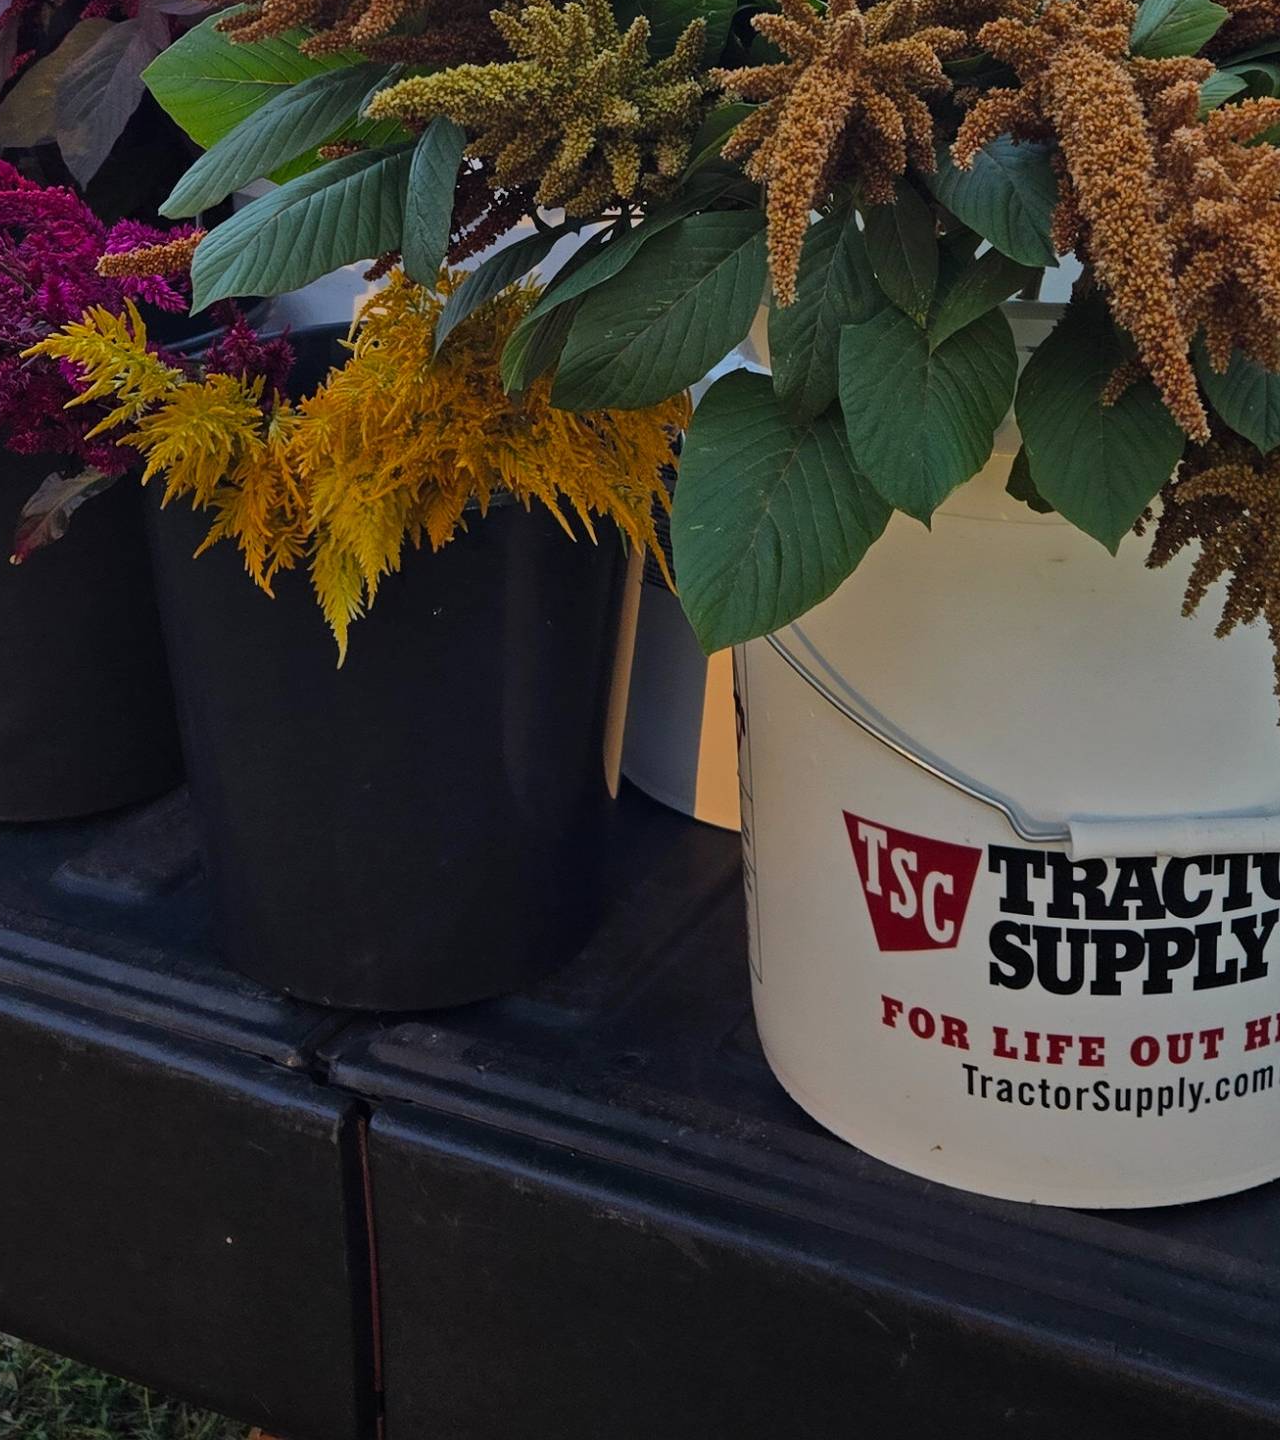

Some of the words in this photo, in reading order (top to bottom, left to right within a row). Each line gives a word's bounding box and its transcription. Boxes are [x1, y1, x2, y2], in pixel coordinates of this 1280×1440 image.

[857, 821, 956, 944] TSC
[988, 908, 1280, 996] SUPPLY
[880, 993, 971, 1051] FOR
[992, 1025, 1106, 1068] LIFE
[1129, 1026, 1225, 1067] OUT
[961, 1062, 1274, 1118] TractorSupply.com
